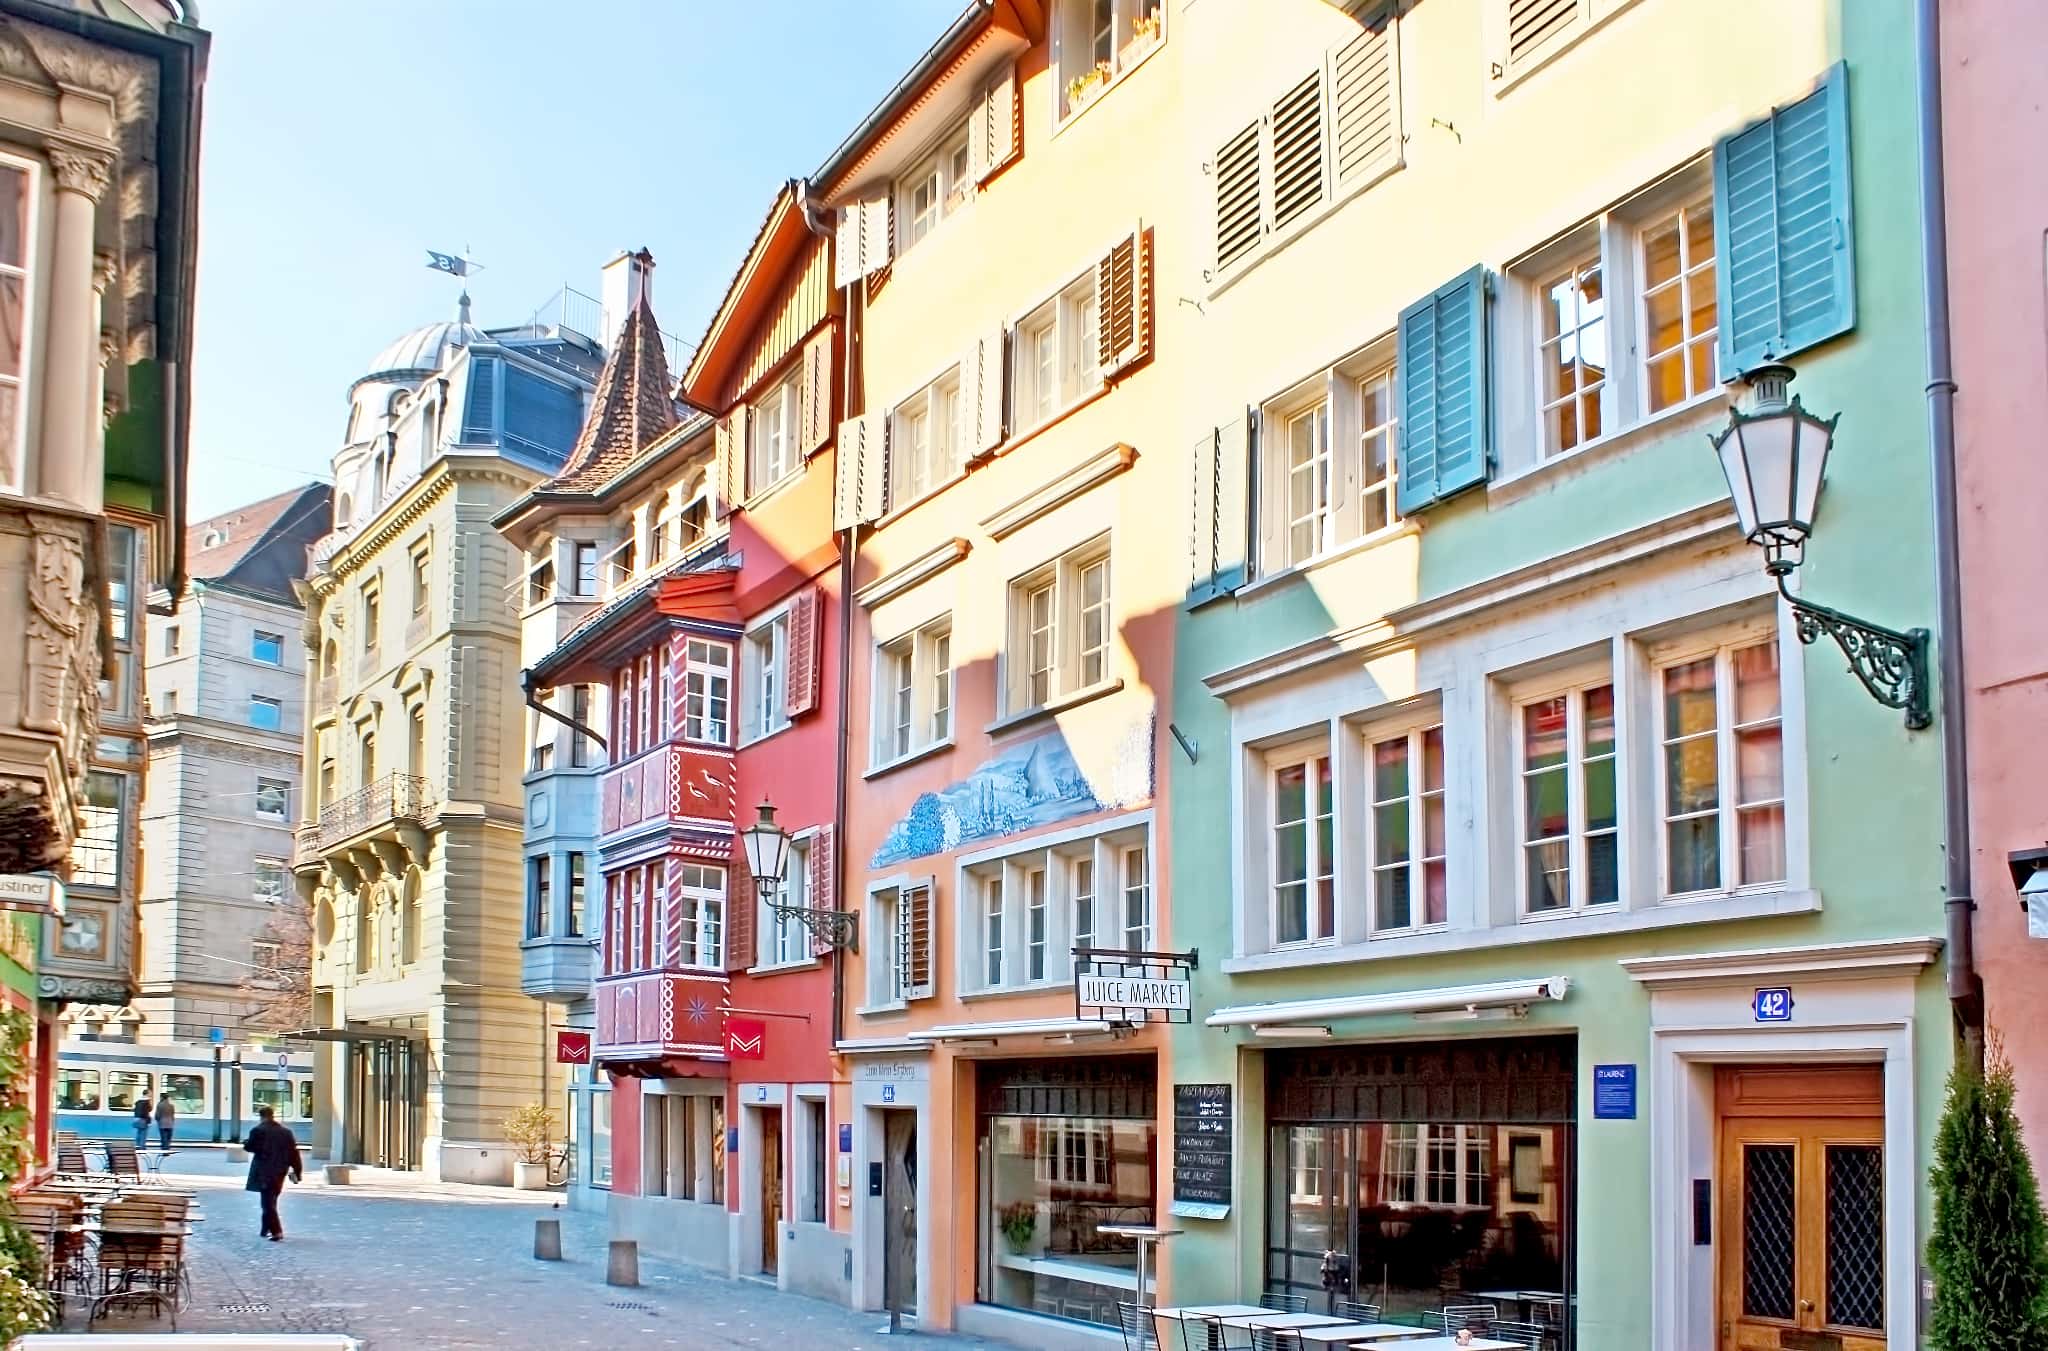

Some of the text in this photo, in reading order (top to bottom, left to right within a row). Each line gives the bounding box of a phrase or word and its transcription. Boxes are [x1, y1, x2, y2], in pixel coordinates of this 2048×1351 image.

[1085, 980, 1184, 1005] JUICE MARKET
[1761, 992, 1784, 1016] 42
